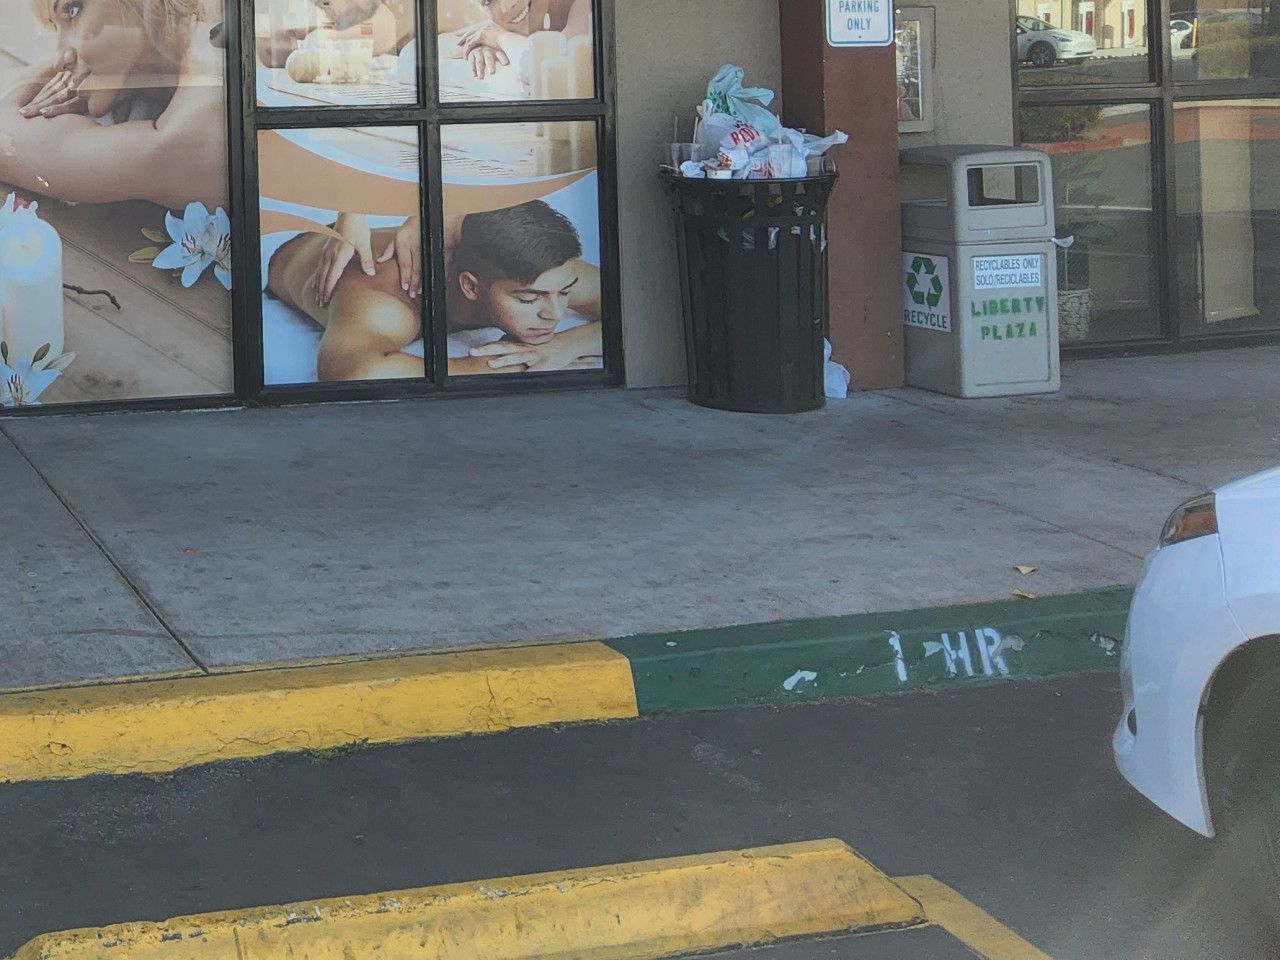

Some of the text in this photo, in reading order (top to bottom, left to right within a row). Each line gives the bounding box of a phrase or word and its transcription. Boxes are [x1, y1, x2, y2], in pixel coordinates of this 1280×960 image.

[839, 1, 880, 13] PARKING
[847, 18, 871, 30] ONLY
[976, 258, 1039, 270] RECYCLABLES ONLY
[971, 296, 1045, 318] LIBERTY
[904, 309, 948, 329] RECYCLE
[981, 322, 1038, 340] PLAZA
[940, 627, 1010, 676] HR
